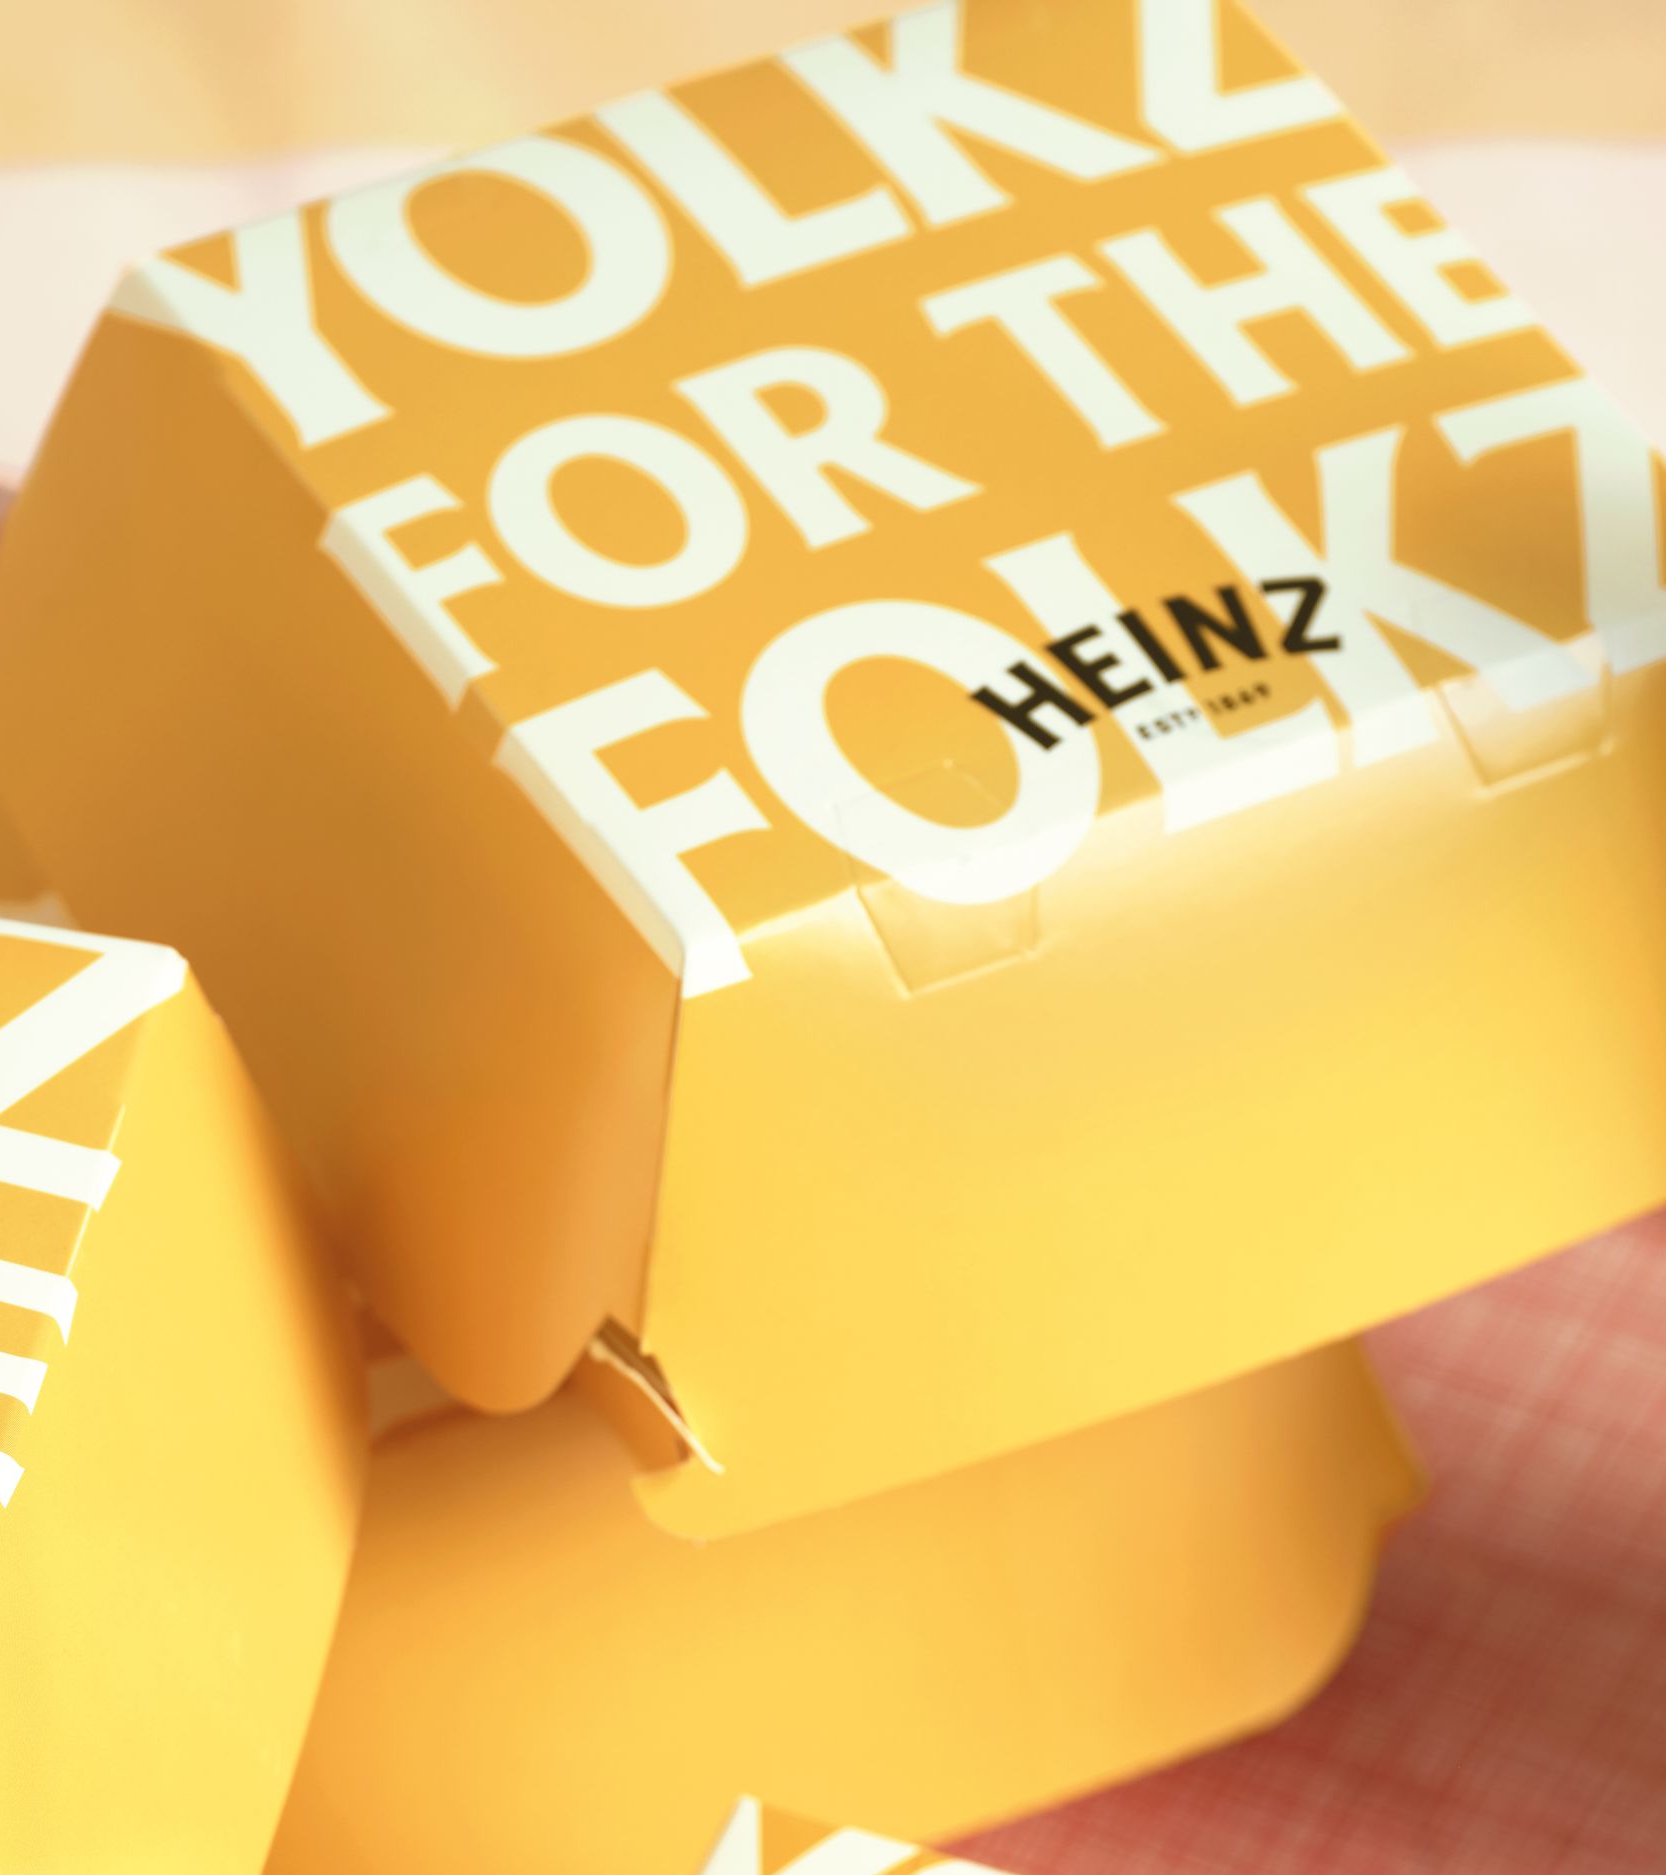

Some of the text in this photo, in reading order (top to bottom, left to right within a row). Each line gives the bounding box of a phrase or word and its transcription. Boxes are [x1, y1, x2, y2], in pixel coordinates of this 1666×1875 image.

[105, 0, 1347, 450] YOLKZ
[317, 165, 1542, 713] FOR THE
[970, 575, 1343, 752] HEINZ
